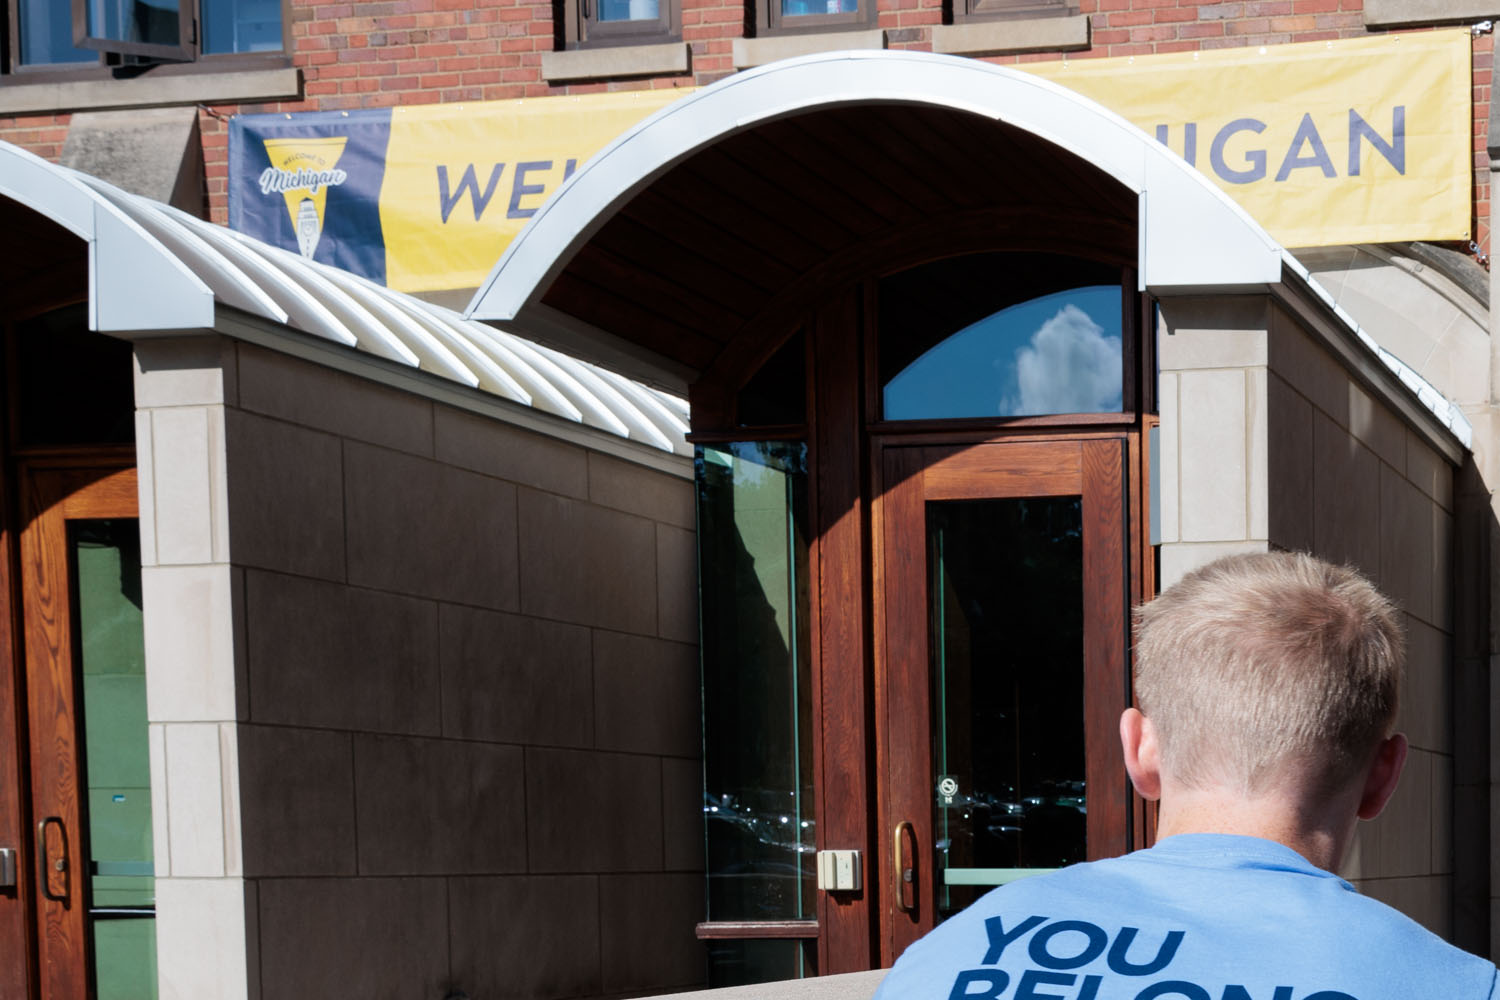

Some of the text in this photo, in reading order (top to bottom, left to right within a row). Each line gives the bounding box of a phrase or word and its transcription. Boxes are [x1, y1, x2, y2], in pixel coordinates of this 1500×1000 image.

[260, 168, 346, 194] Michigan
[436, 106, 1405, 224] WE IGAN
[981, 916, 1185, 976] YOU
